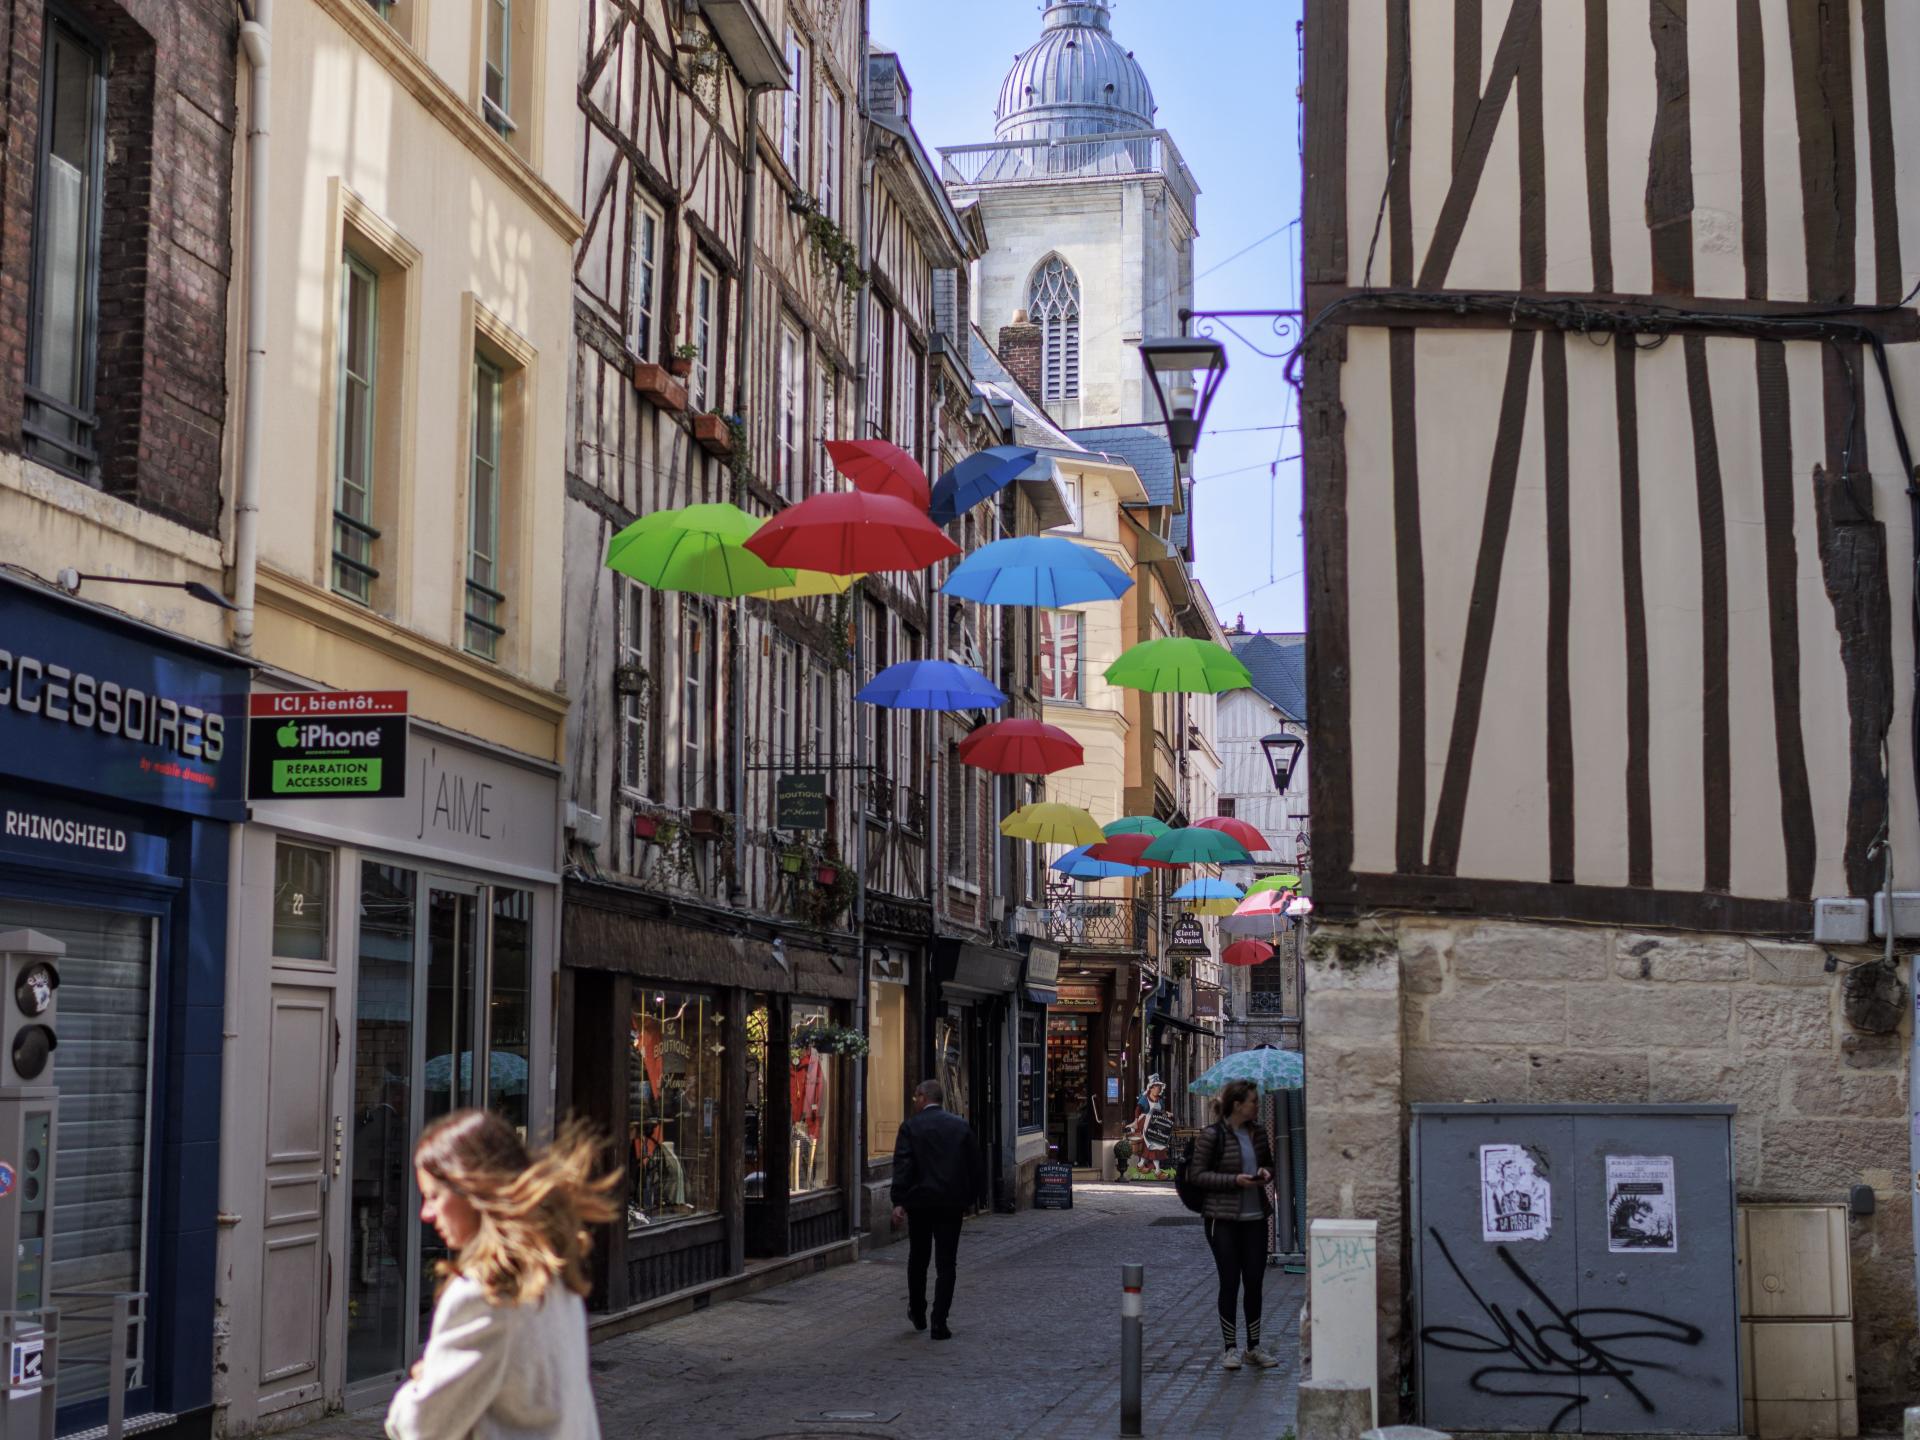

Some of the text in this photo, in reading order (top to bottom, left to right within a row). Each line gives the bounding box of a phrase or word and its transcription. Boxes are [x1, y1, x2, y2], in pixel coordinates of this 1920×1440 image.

[301, 724, 381, 747] iPhone
[286, 776, 368, 788] ACCESSOIRES
[779, 791, 823, 800] BOUTIQUE
[5, 810, 127, 853] RHINOSHIELD
[293, 892, 304, 915] 22
[1176, 930, 1200, 938] Cloche
[653, 1040, 690, 1059] BOUTIQUE
